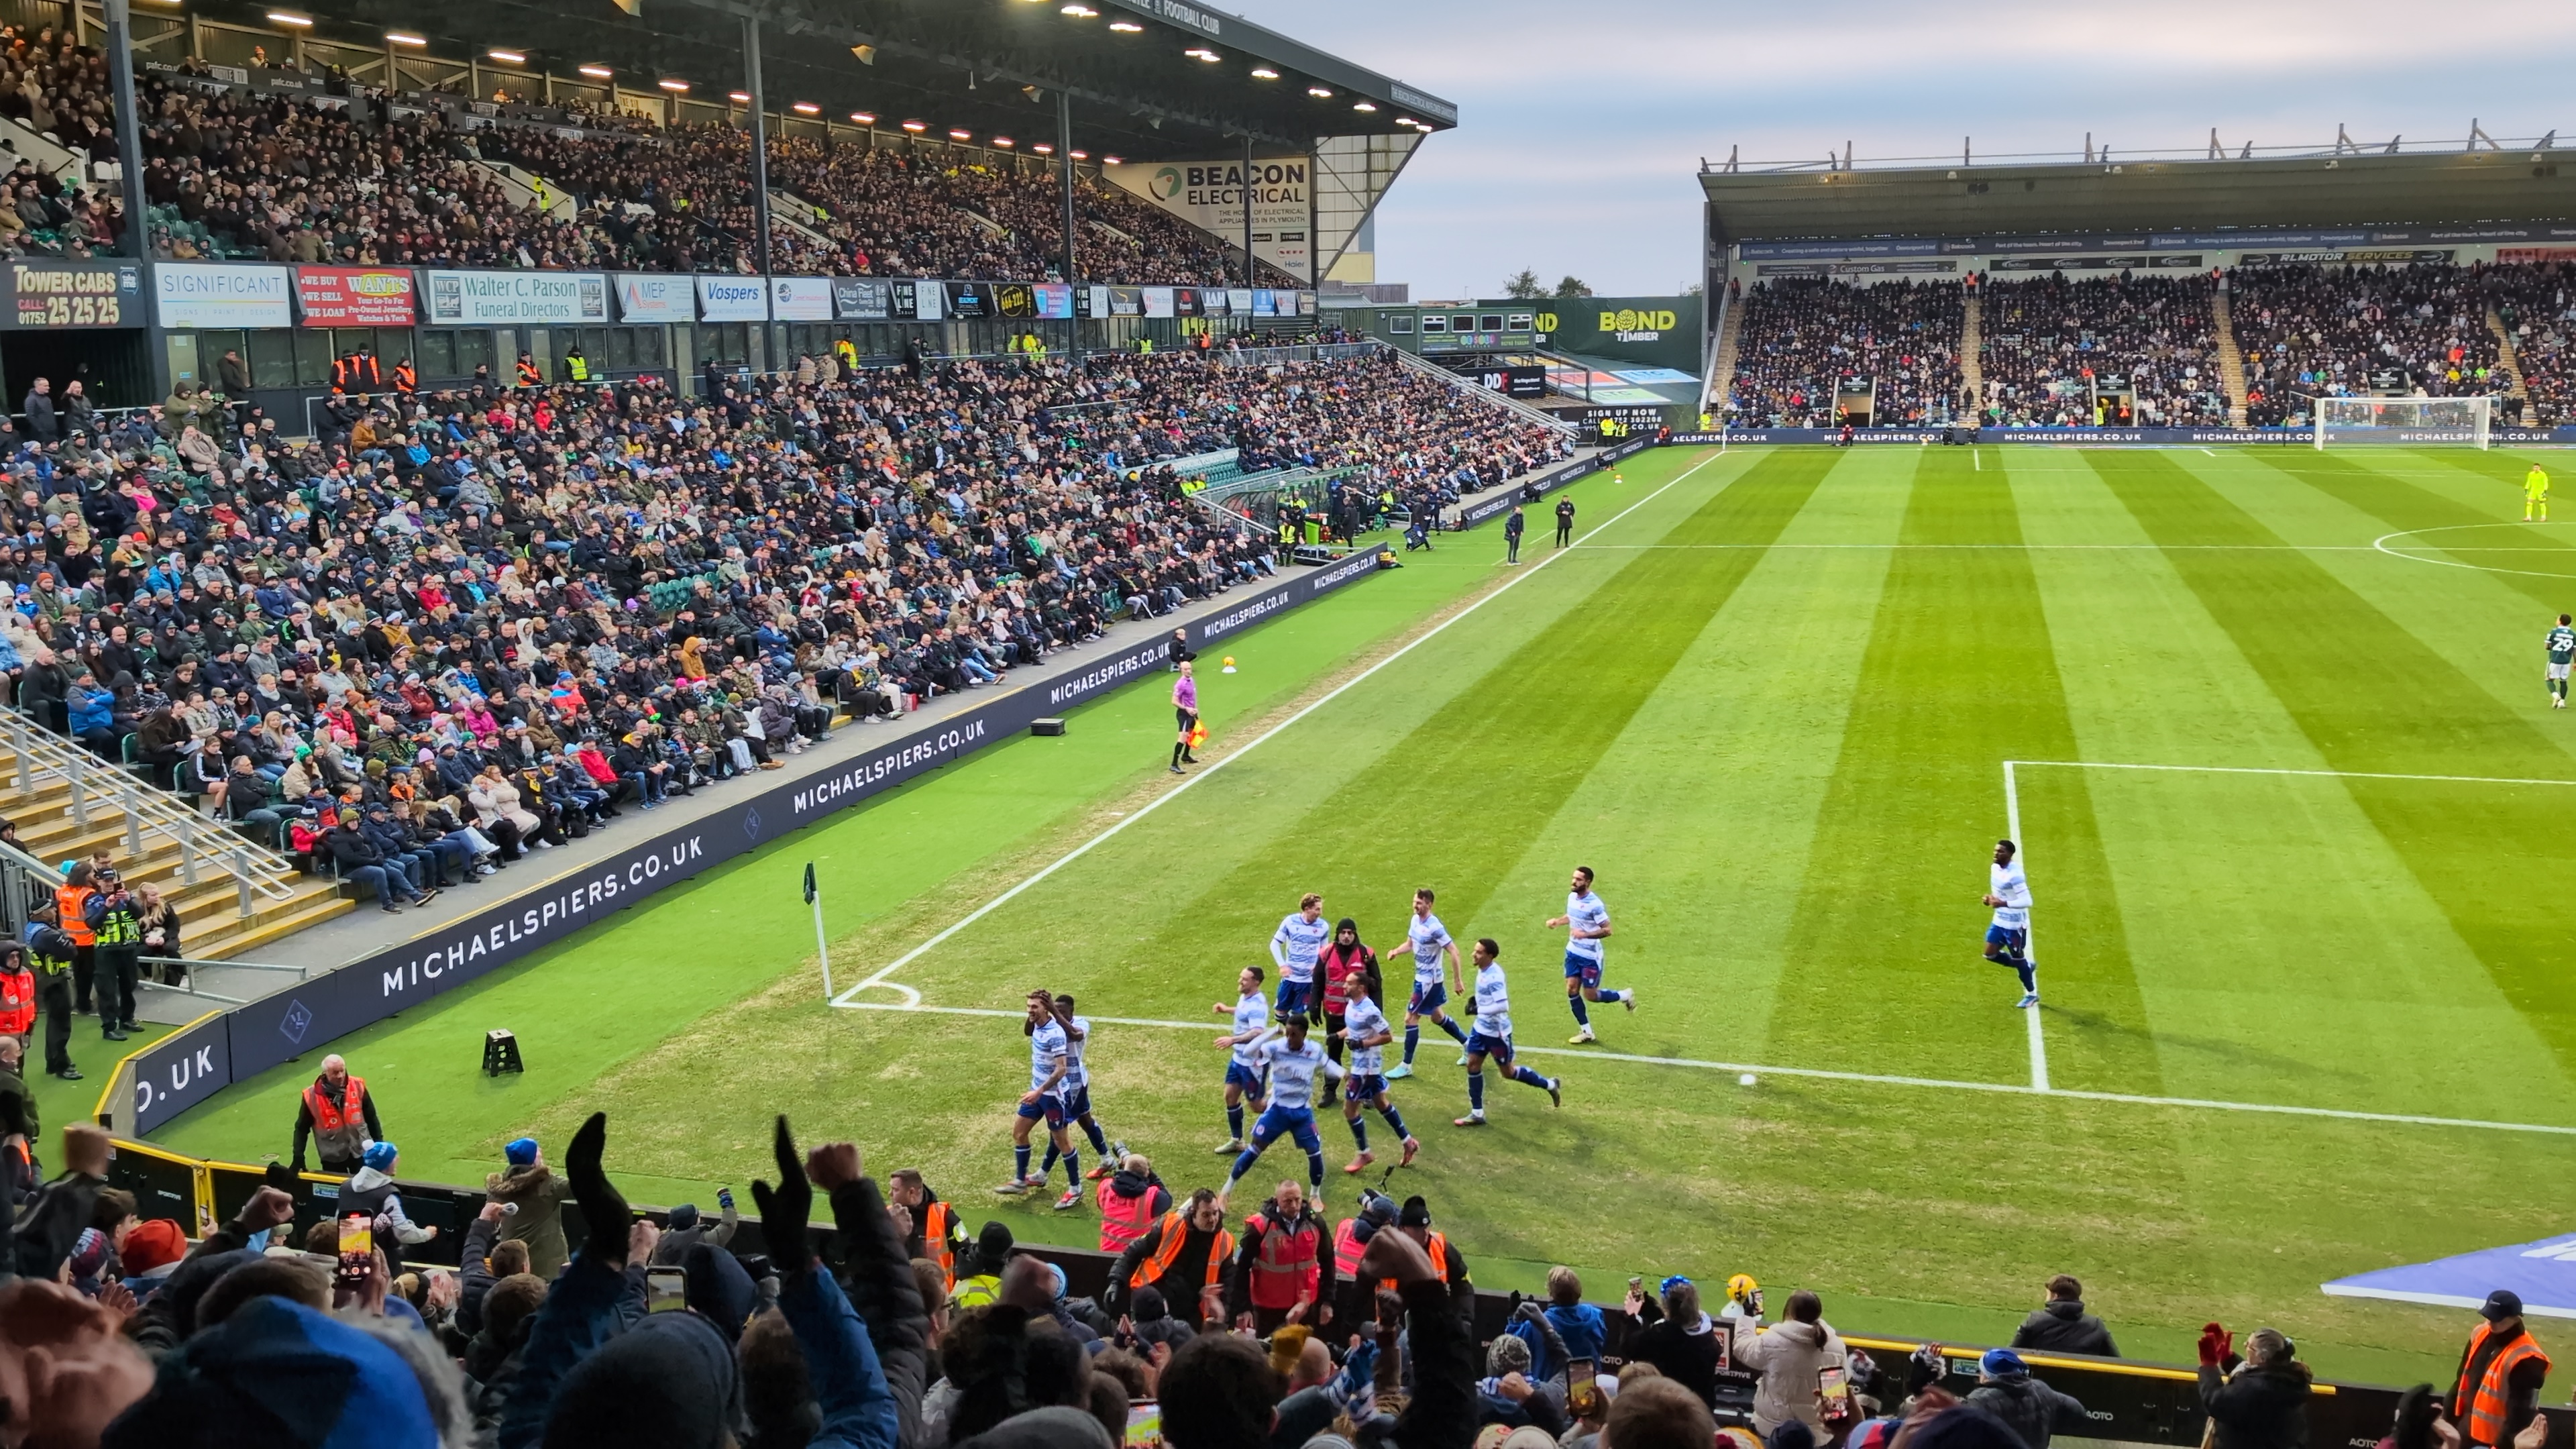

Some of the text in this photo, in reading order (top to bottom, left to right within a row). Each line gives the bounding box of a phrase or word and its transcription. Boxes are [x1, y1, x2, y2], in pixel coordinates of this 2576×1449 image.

[1163, 0, 1201, 28] FOOTBALL
[1201, 14, 1220, 35] CLUB
[146, 61, 180, 72] pafc.co.u
[271, 78, 304, 89] pafc.co.uk
[1187, 164, 1304, 186] BEACON
[1188, 188, 1305, 205] ELECTRICAL
[1219, 216, 1260, 225] APPLIANES
[2345, 252, 2414, 260] SERVICES
[1285, 260, 1305, 268] Haier
[1840, 264, 1885, 273] Custom Gas
[13, 265, 116, 293] TOWER CABS
[164, 274, 281, 294] SIGNIFICANT
[304, 276, 338, 286] WE BUY
[345, 276, 411, 293] WANTS
[435, 280, 460, 293] WCP
[464, 276, 577, 297] Walter C. Parson
[580, 282, 601, 294] WCP
[641, 282, 665, 299] MEP
[708, 282, 759, 304] Vospers
[839, 287, 874, 299] China Fleet
[305, 292, 343, 301] WE SELL
[18, 297, 119, 325] CALL: 25 25 25
[307, 308, 345, 317] WE LOAN
[475, 301, 570, 317] Funeral Directors
[642, 300, 666, 311] Systems
[19, 311, 46, 325] 01752
[1535, 313, 1558, 332] ND
[1599, 309, 1676, 331] BOND
[1615, 331, 1659, 342] TIMBER
[1631, 408, 1657, 416] NOW
[2004, 433, 2141, 443] MICHAELSPIERS.CO.UK
[1313, 553, 1377, 589] MICHAELSPIERS.CO.UK
[1204, 591, 1289, 639] MICHAELSPIERS.CO.UK
[2552, 637, 2573, 652] 29
[1051, 641, 1171, 704] MICHAELSPIERS.CO.UK
[794, 718, 985, 814] MICHAELSPIERS.CO.UK
[382, 835, 703, 997] MICHAELSPIERS.CO.UK
[1715, 1369, 1751, 1379] PORTFIVE
[2086, 1410, 2114, 1421] AOTO
